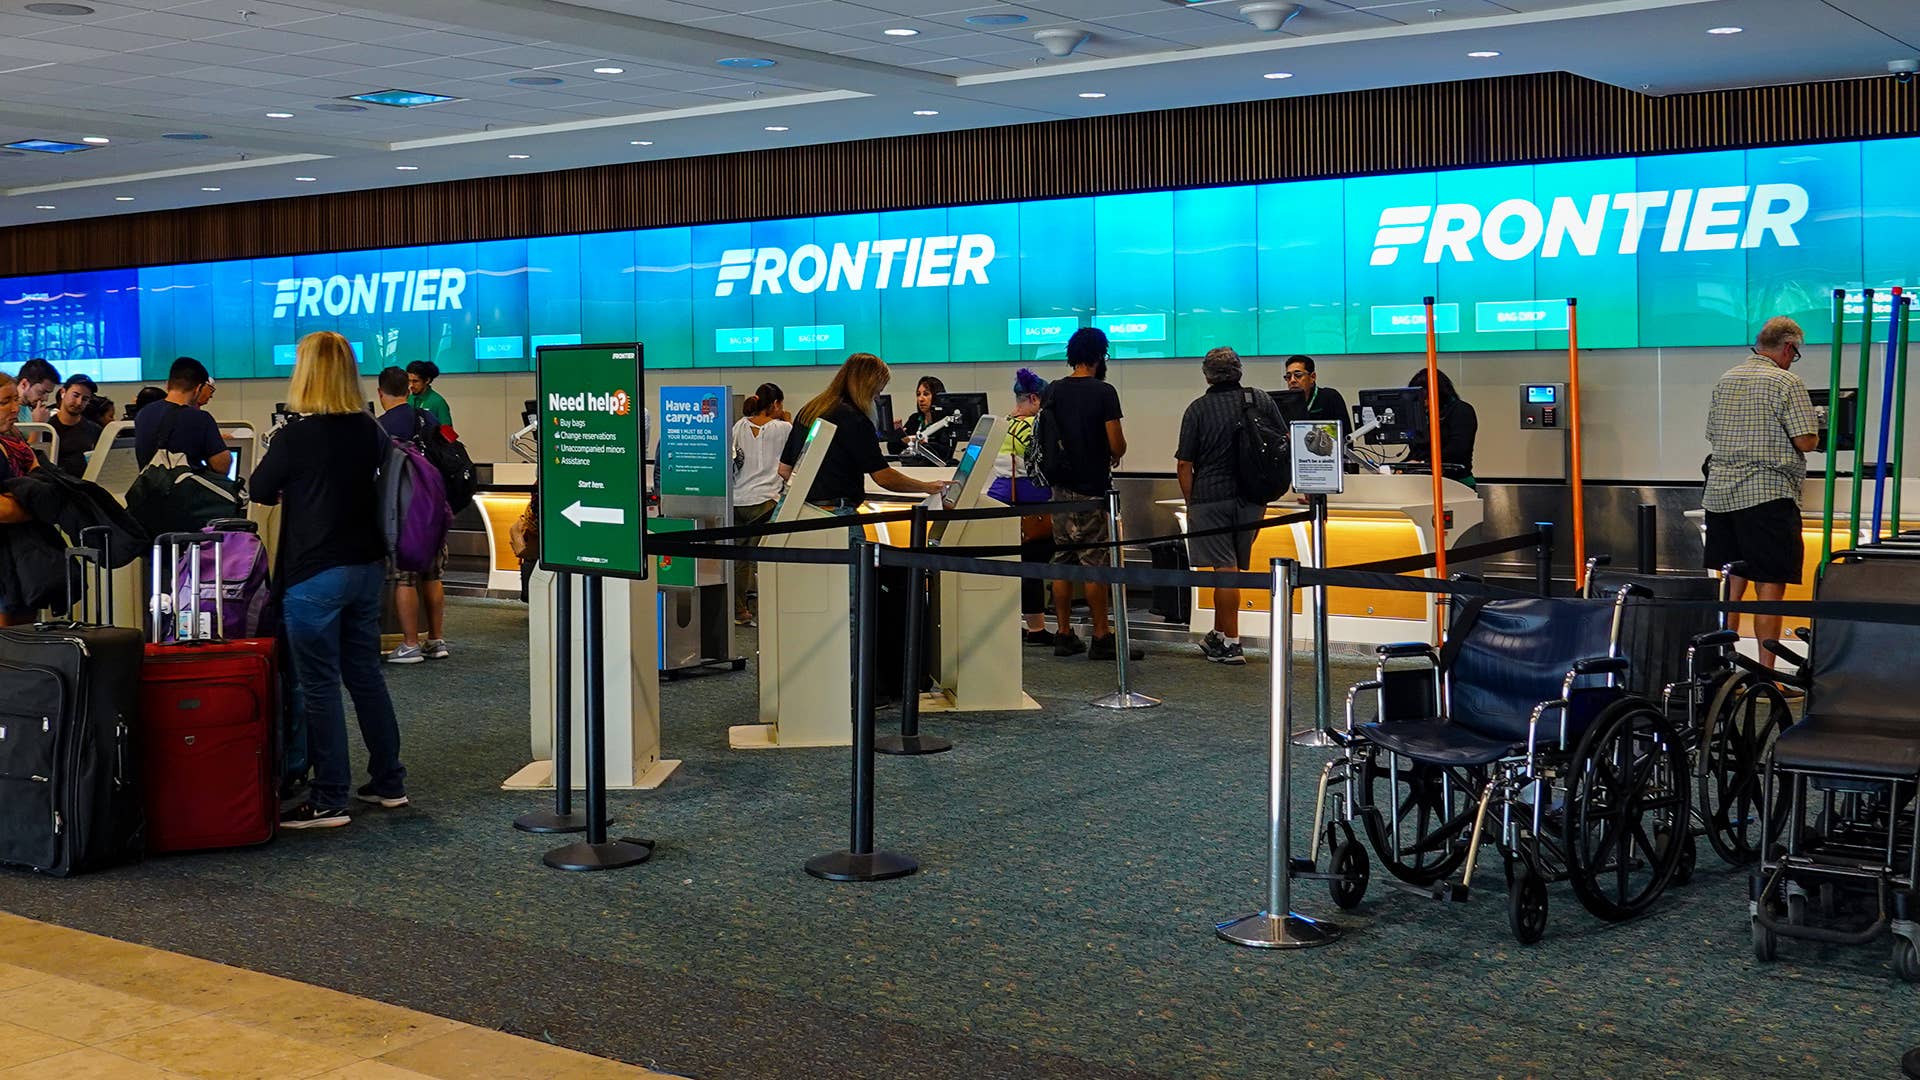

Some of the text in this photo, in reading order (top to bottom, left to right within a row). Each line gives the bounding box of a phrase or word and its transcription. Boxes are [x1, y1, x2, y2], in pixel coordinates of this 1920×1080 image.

[1369, 183, 1809, 265] FRONTIER
[715, 233, 996, 297] FRONTIER
[273, 267, 466, 318] FRONTIER
[1497, 311, 1546, 322] BAG DROP
[1025, 326, 1061, 336] BAG DROP
[1109, 324, 1148, 333] BAG DROP
[548, 392, 627, 415] Need help?
[665, 400, 700, 411] Have a
[560, 418, 586, 429] Buy bags
[665, 411, 715, 425] carry-on?
[560, 431, 617, 441] Change reservations
[560, 444, 626, 454] Unaccompanied minors
[561, 456, 590, 466] Assistance
[578, 479, 605, 489] Start here.
